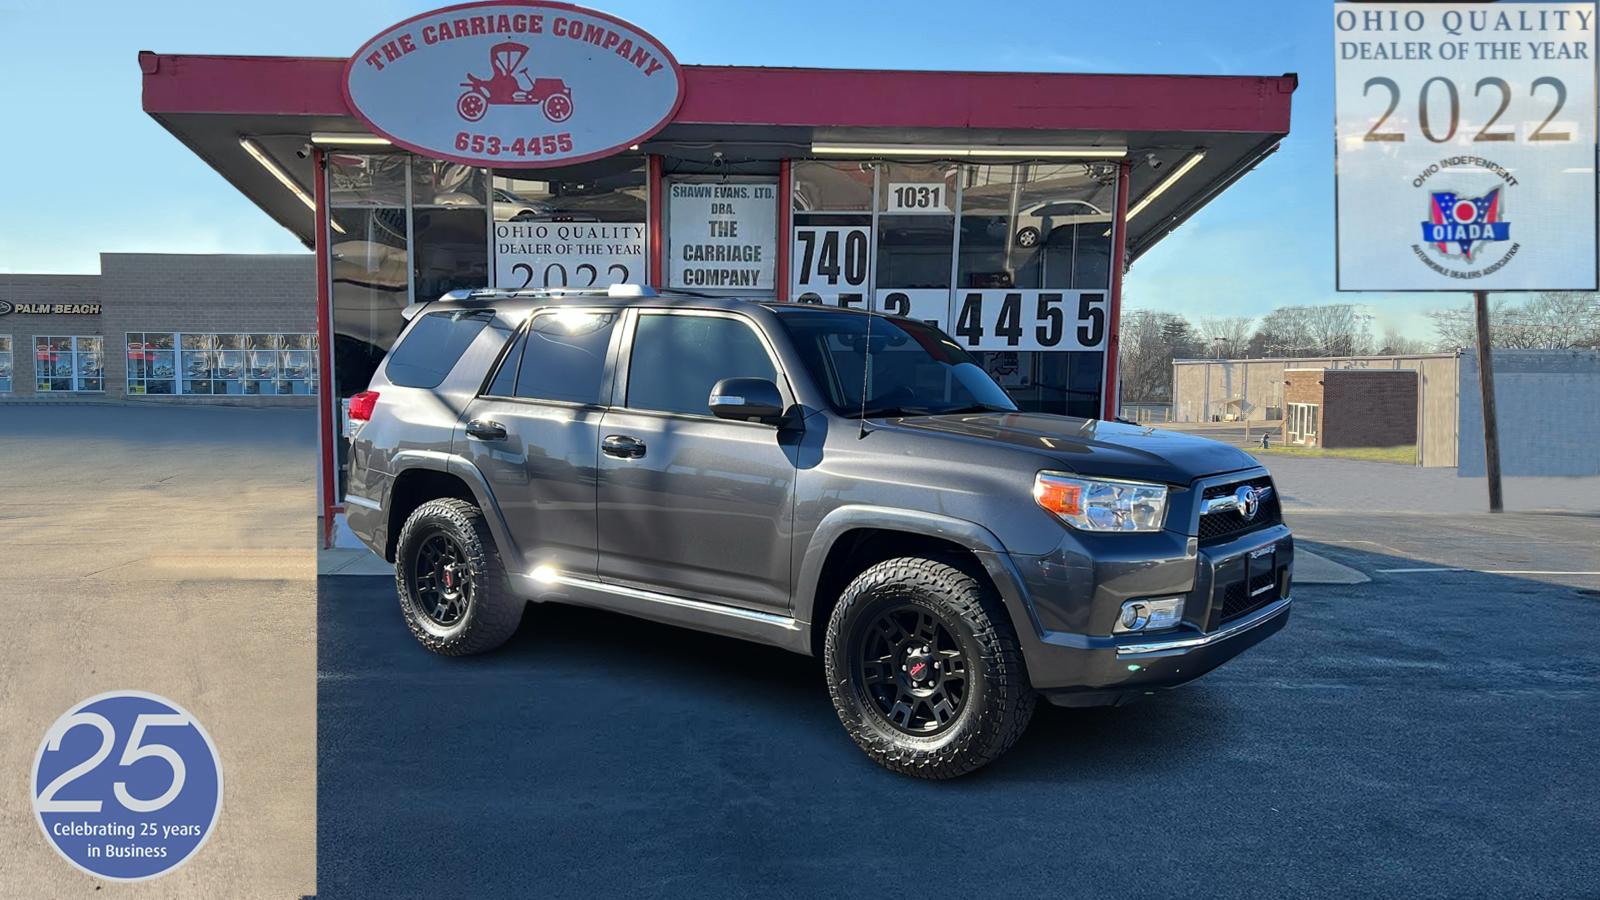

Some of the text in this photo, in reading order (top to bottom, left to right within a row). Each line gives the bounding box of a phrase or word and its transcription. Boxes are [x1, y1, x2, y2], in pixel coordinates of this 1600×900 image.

[1336, 10, 1593, 36] OHIO QUALITY
[365, 14, 664, 77] THE CARRIAGE COMPANY
[1340, 42, 1589, 60] DEALER OF THE YEAR
[1362, 76, 1571, 143] 2022
[454, 132, 573, 156] 653-4455
[1412, 155, 1519, 188] OHIO INDEPENDENT
[672, 186, 712, 199] SHAWN
[894, 187, 940, 208] 1031
[711, 203, 736, 215] DBA.
[496, 225, 644, 241] OHIO QUALITY
[708, 220, 738, 238] THE
[1432, 225, 1495, 240] OIADA
[499, 243, 641, 255] DEALER OF THE YEAR
[682, 244, 762, 262] CARRIAGE
[797, 230, 868, 286] 740
[683, 268, 760, 286] COMPANY
[14, 303, 100, 314] PALM BEACH
